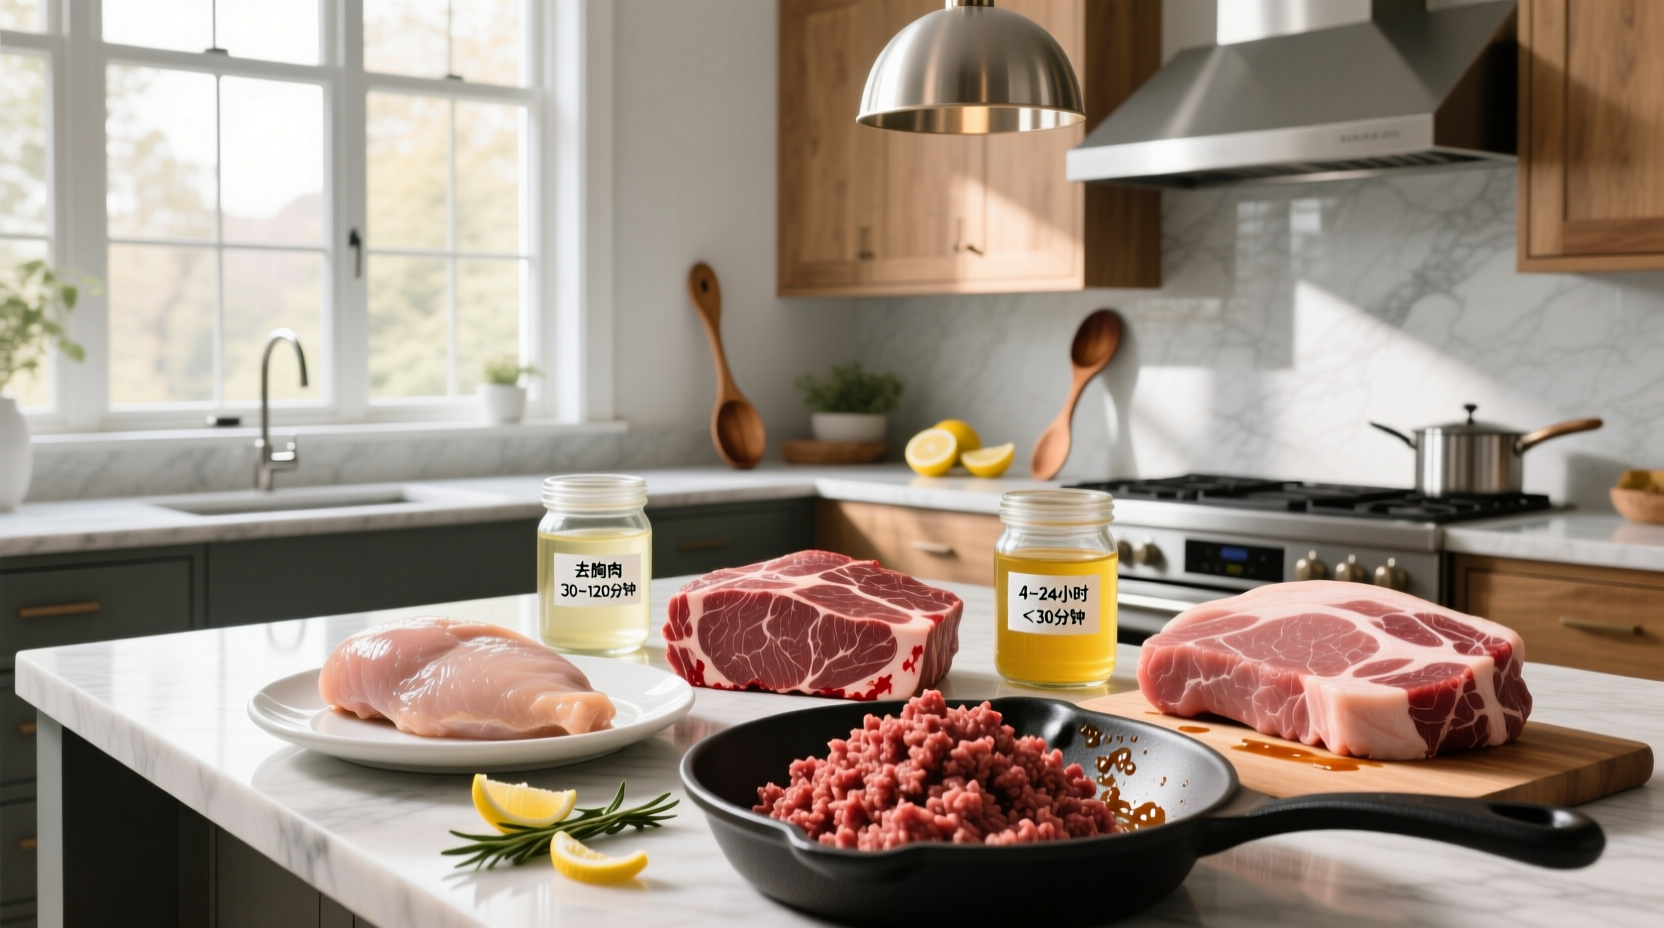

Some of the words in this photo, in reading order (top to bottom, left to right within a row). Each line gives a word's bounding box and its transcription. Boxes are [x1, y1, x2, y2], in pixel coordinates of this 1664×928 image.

[560, 582, 636, 599] 30-120分钟
[1018, 584, 1089, 604] 4-24小时
[1022, 607, 1086, 626] <30分钟
